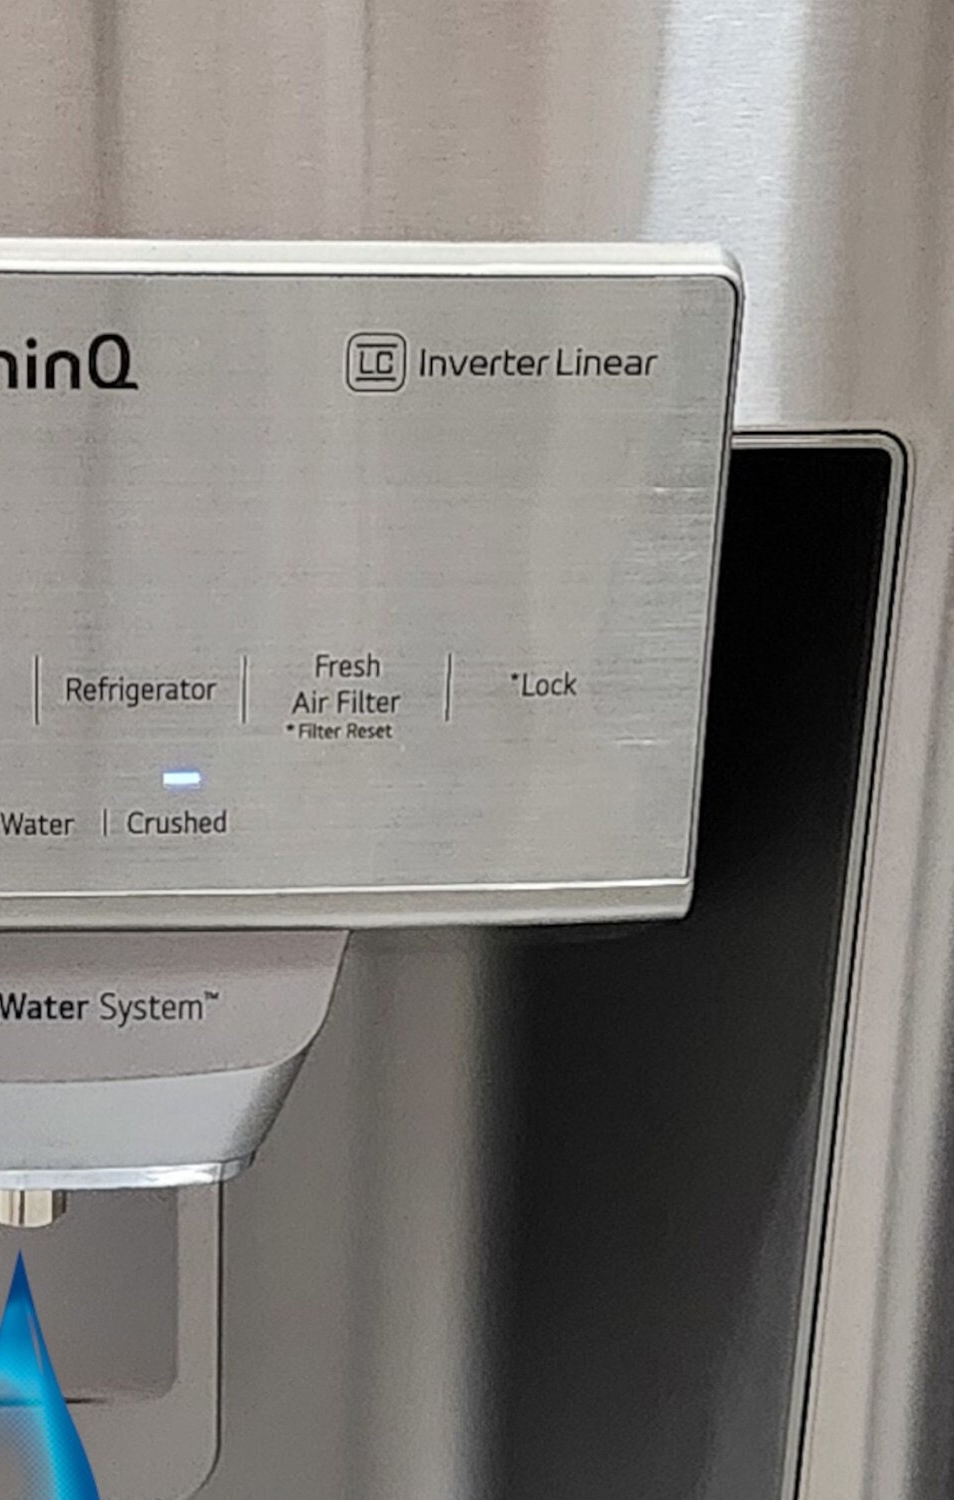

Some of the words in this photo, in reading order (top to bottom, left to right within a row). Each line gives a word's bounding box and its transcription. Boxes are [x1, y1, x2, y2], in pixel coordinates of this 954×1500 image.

[420, 348, 550, 376] Inverter
[556, 348, 658, 376] Linear
[316, 652, 380, 678] Fresh
[65, 676, 218, 708] Refrigerator
[292, 690, 329, 715] Air
[337, 689, 401, 714] Filter
[347, 723, 392, 740] Reset
[0, 811, 75, 836] Water
[126, 809, 228, 835] Crushed
